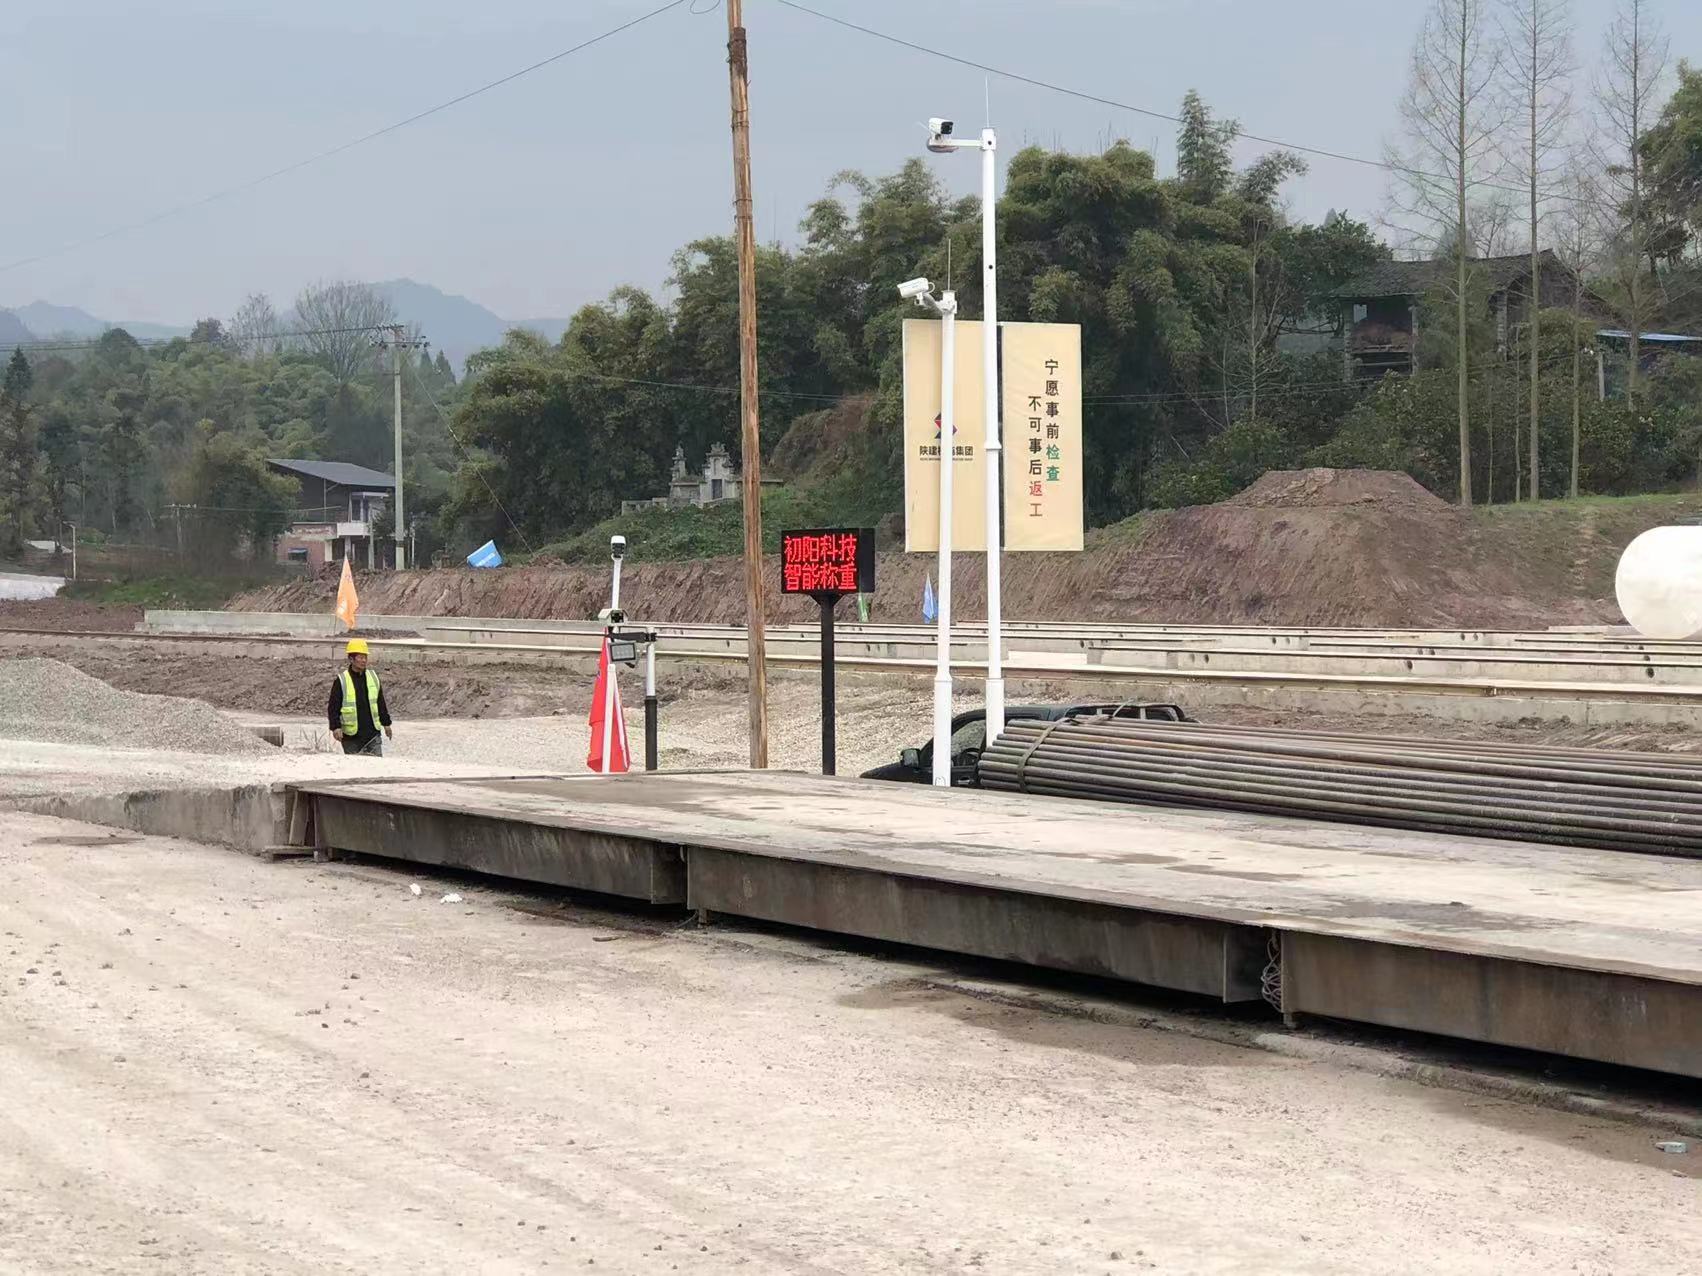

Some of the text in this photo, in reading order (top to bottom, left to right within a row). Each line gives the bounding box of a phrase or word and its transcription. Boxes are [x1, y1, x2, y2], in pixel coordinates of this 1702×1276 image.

[1045, 359, 1060, 482] 宁愿事前检查
[919, 445, 974, 456] 陕建集团
[1028, 396, 1044, 517] 不可事后返工
[784, 533, 857, 562] 初阳科技
[784, 562, 857, 590] 智能称重
